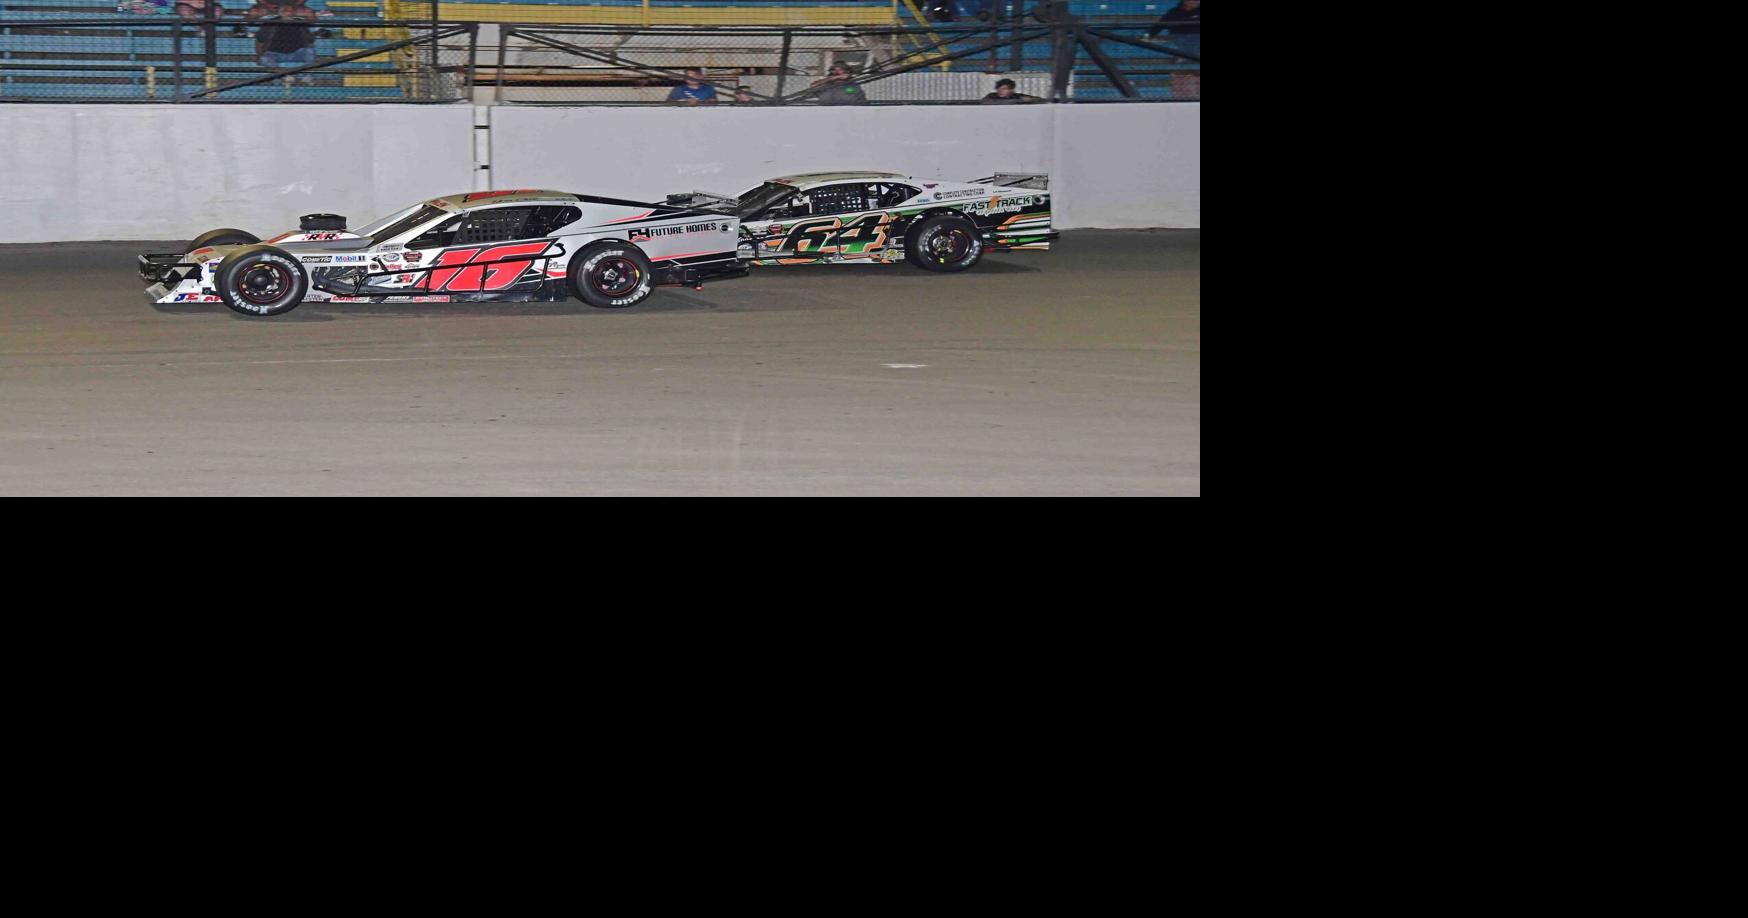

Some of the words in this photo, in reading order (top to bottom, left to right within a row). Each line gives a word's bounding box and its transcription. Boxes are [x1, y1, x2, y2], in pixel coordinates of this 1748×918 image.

[963, 202, 990, 213] FAST
[994, 197, 1031, 210] TRACK
[651, 226, 683, 237] FUTURE
[686, 222, 717, 234] HOMES
[777, 211, 890, 254] 64
[335, 255, 356, 263] Mobil
[414, 241, 551, 291] 16
